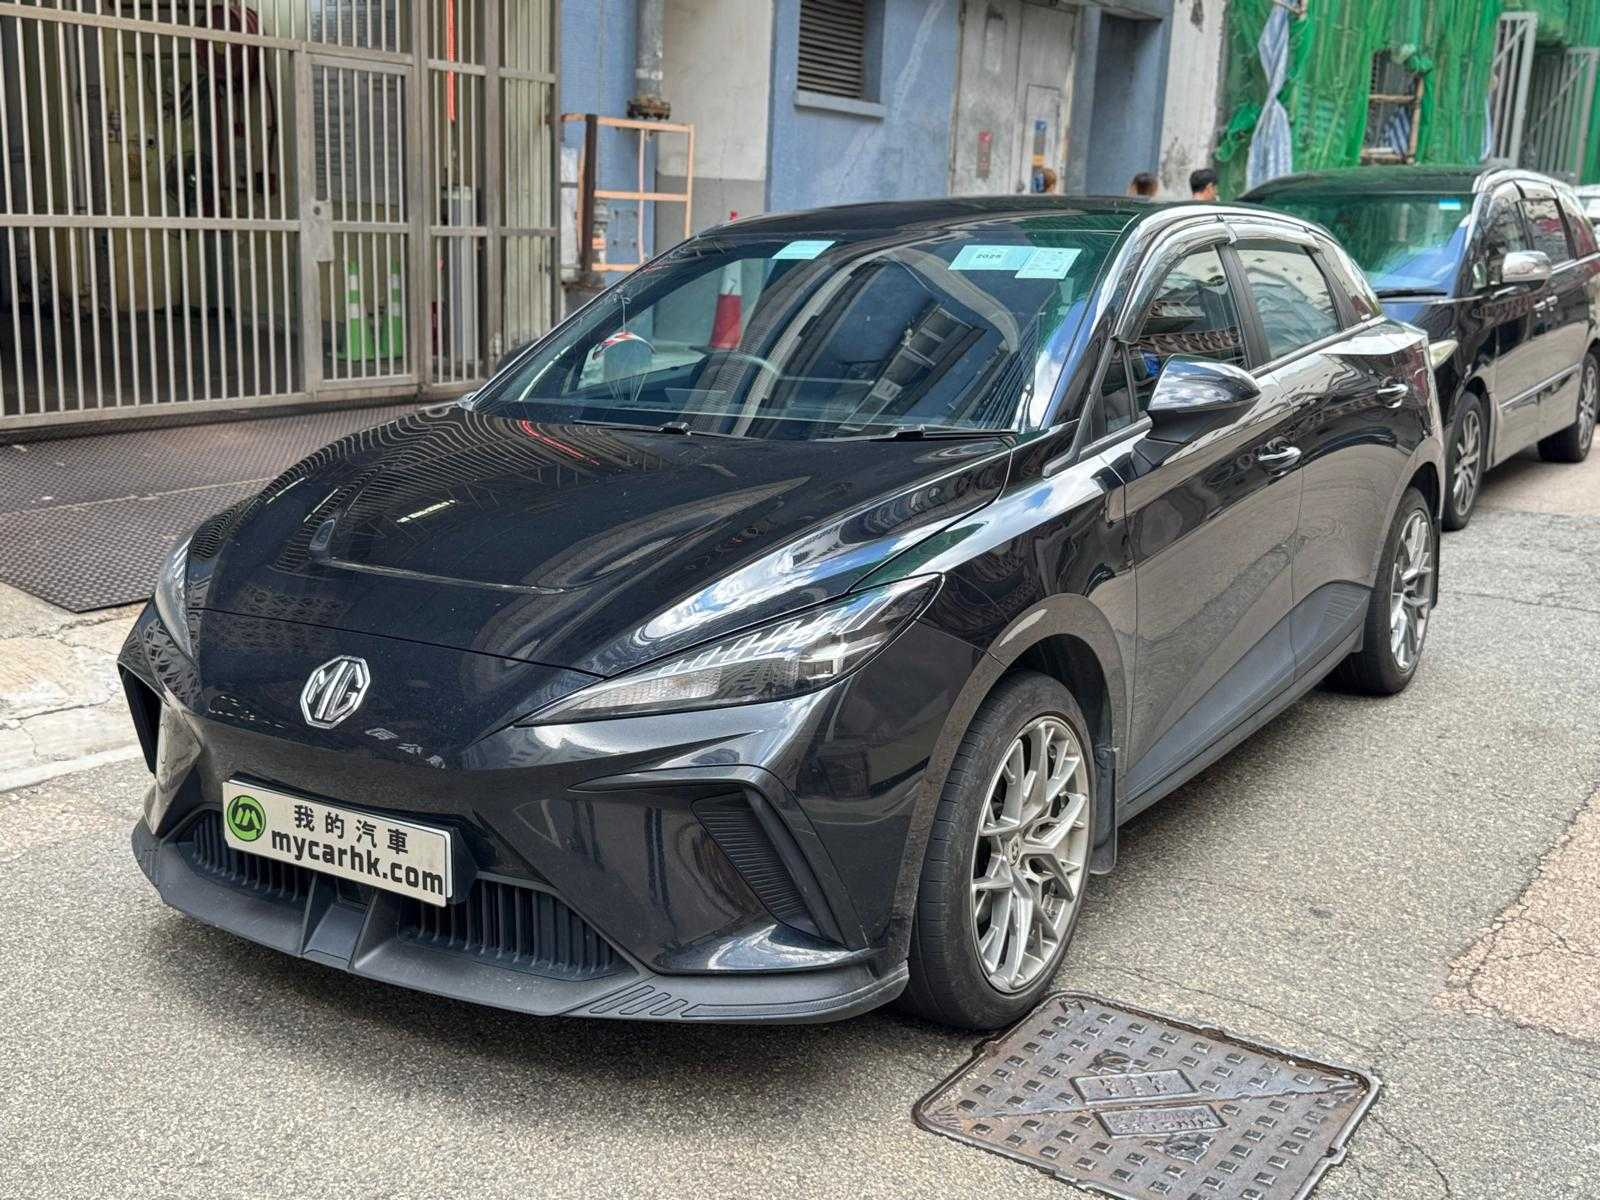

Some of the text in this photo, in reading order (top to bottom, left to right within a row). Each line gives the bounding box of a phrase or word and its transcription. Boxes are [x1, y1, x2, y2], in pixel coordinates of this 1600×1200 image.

[306, 660, 364, 721] MG
[293, 804, 409, 855] 我的汽車
[271, 829, 444, 895] mycarhk.com
